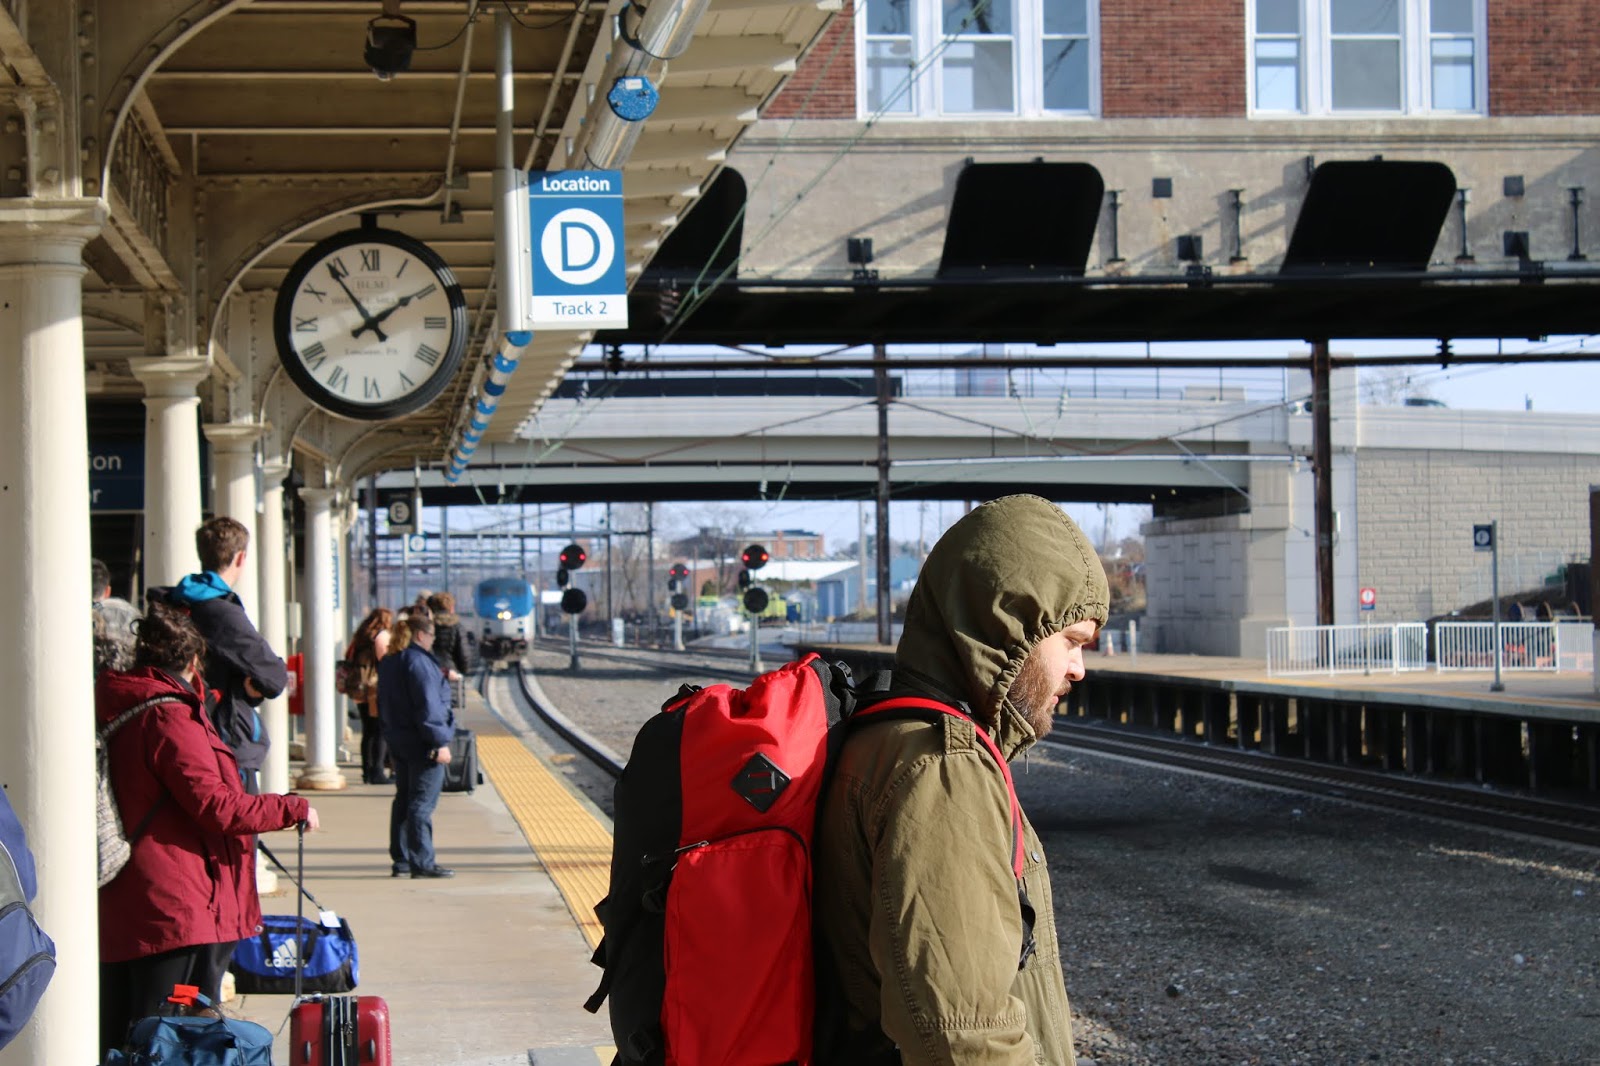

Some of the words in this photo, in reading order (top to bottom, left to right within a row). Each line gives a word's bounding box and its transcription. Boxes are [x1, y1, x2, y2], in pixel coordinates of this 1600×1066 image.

[542, 176, 610, 191] Location
[560, 222, 601, 271] D
[360, 249, 380, 271] XII
[552, 301, 593, 315] Track
[599, 301, 608, 315] 2
